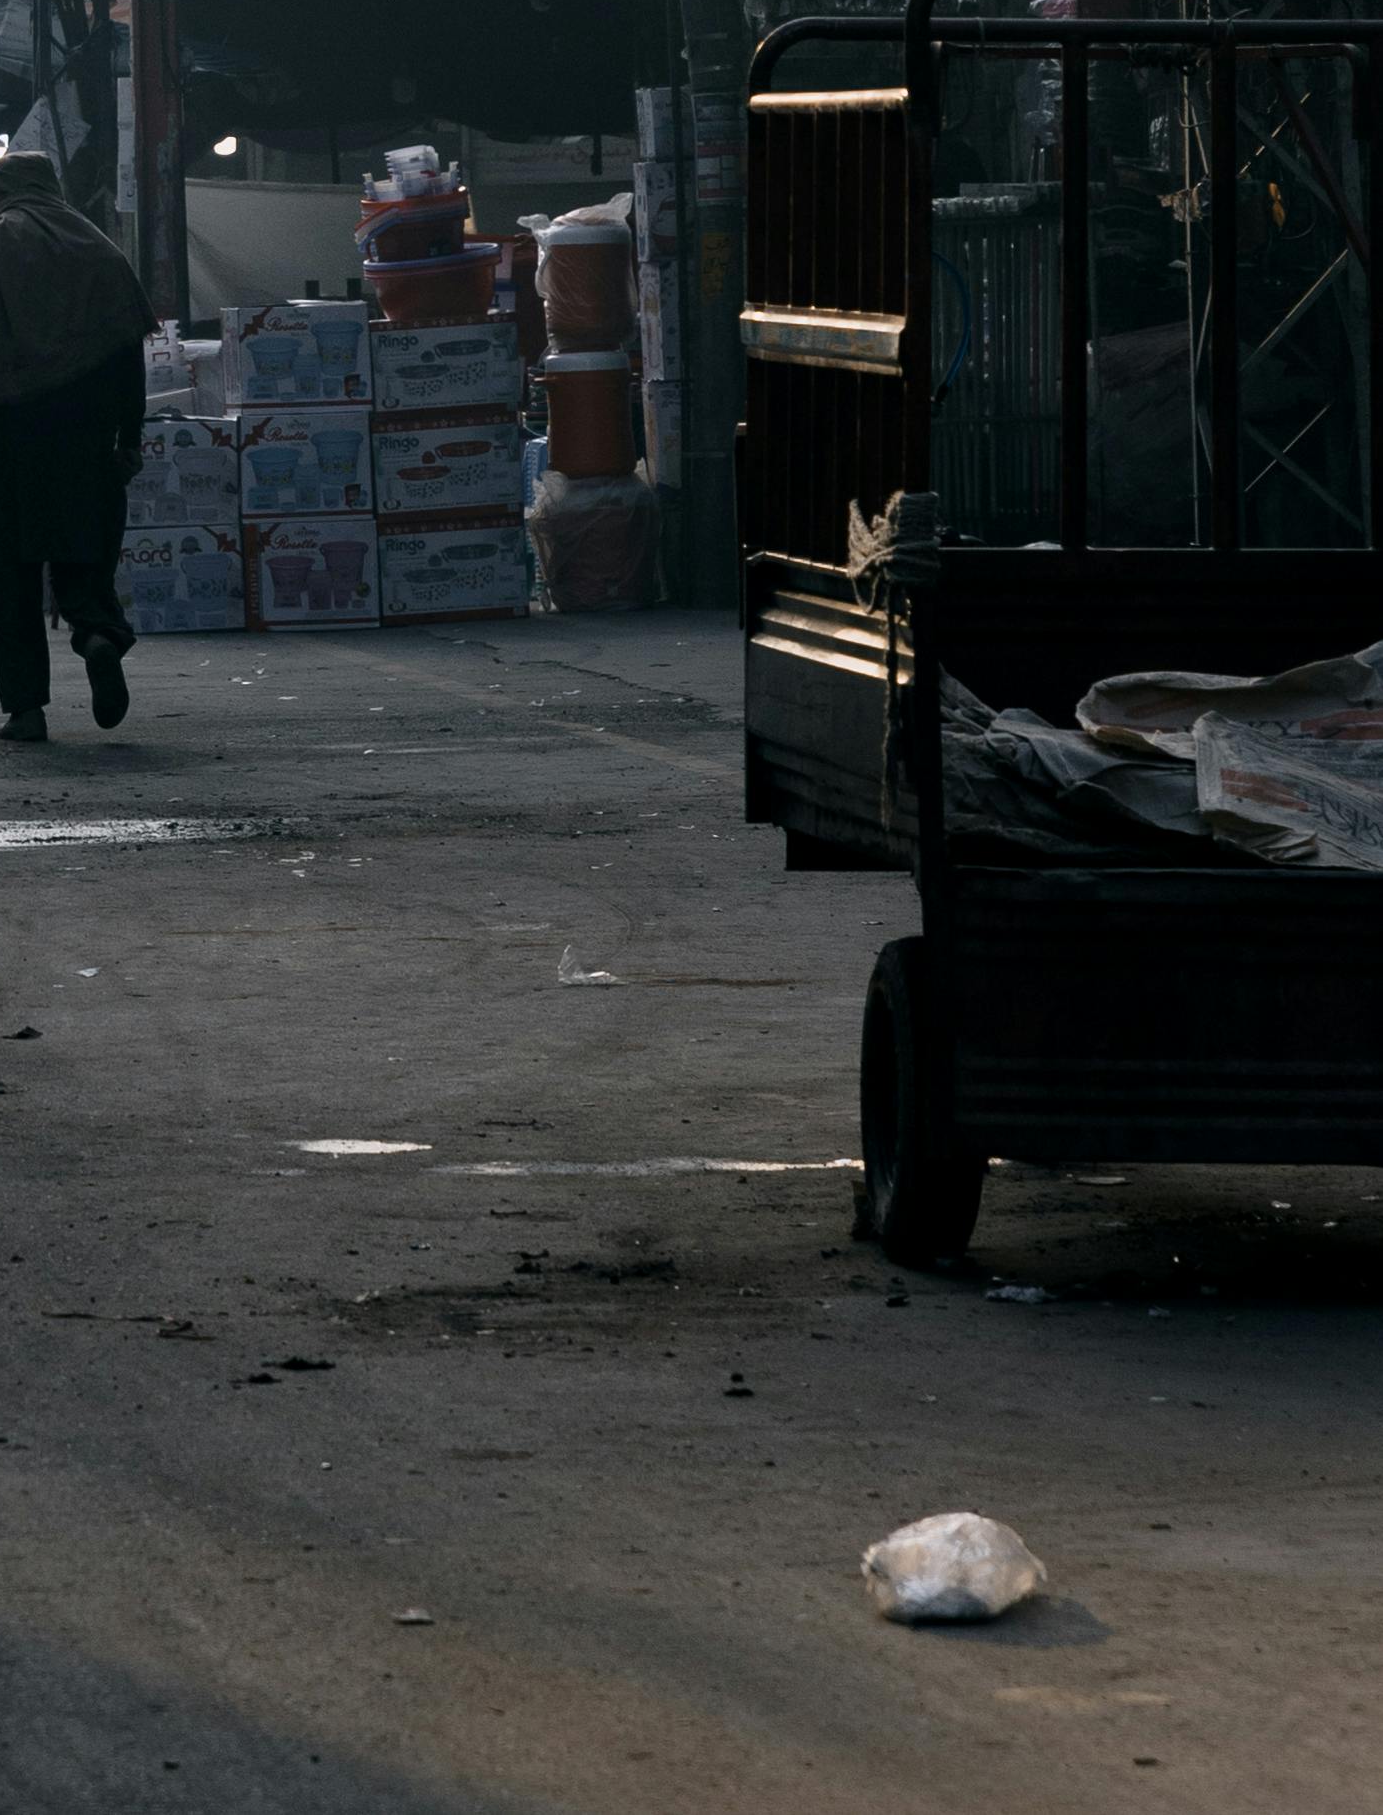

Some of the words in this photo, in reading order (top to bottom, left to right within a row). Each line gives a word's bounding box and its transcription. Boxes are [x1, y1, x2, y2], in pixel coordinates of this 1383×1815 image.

[377, 334, 419, 352] Ringo
[378, 436, 420, 453] Ringo
[385, 538, 427, 556] Ringo
